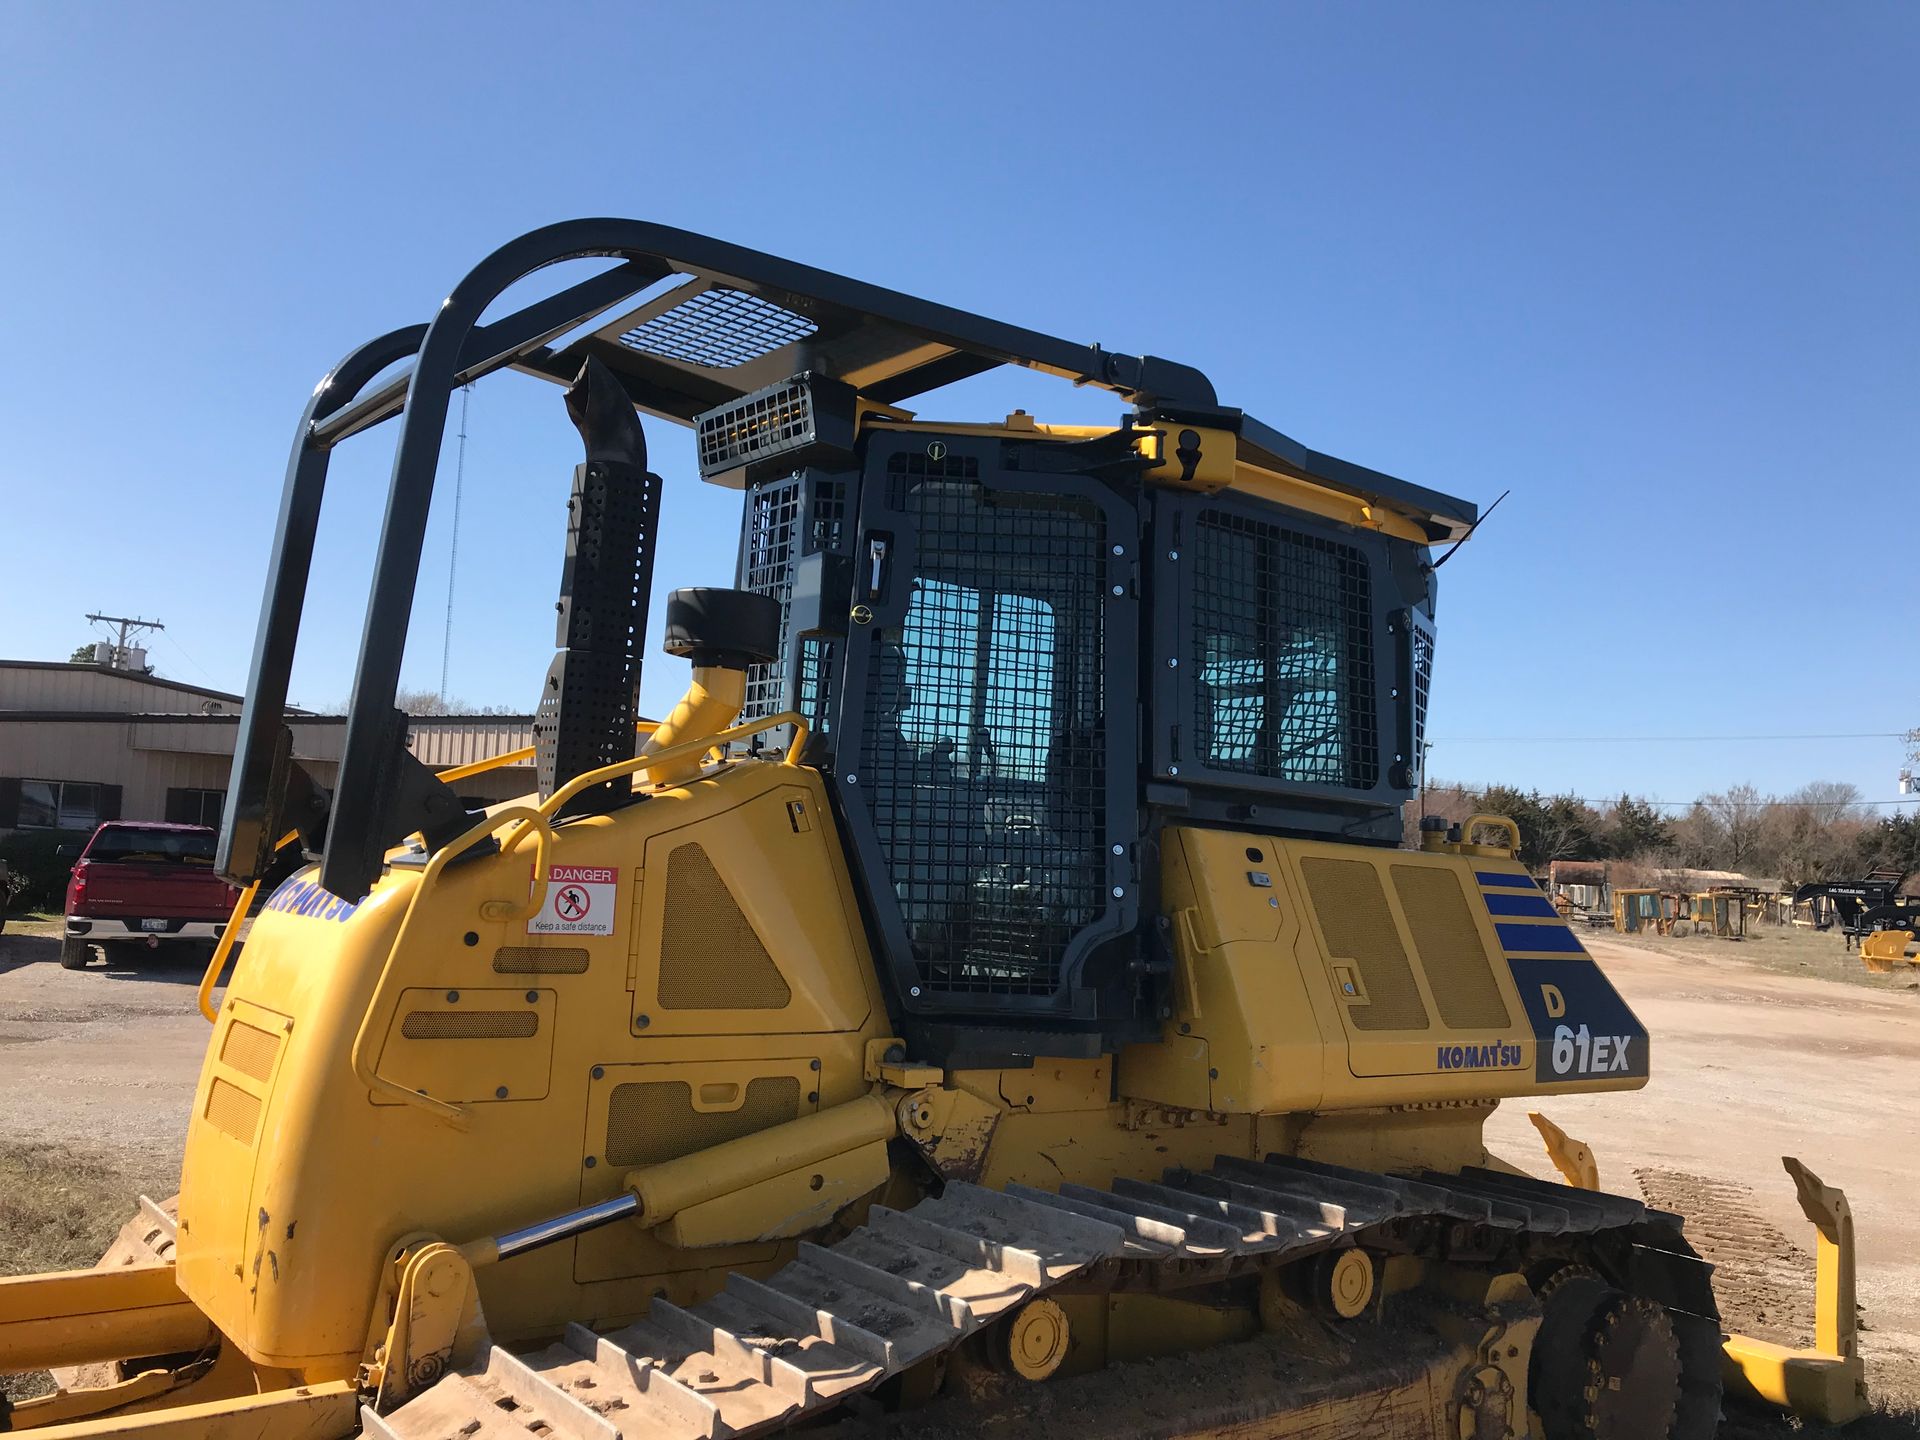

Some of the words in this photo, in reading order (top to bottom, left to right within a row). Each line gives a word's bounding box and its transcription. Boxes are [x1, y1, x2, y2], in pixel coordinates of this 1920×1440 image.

[553, 868, 612, 882] DANGER
[535, 922, 554, 931] Keep
[561, 922, 577, 931] safe
[577, 922, 607, 931] distance
[1540, 984, 1566, 1018] D
[1437, 1039, 1521, 1069] KOMATSU
[1552, 1023, 1631, 1075] 61EX
